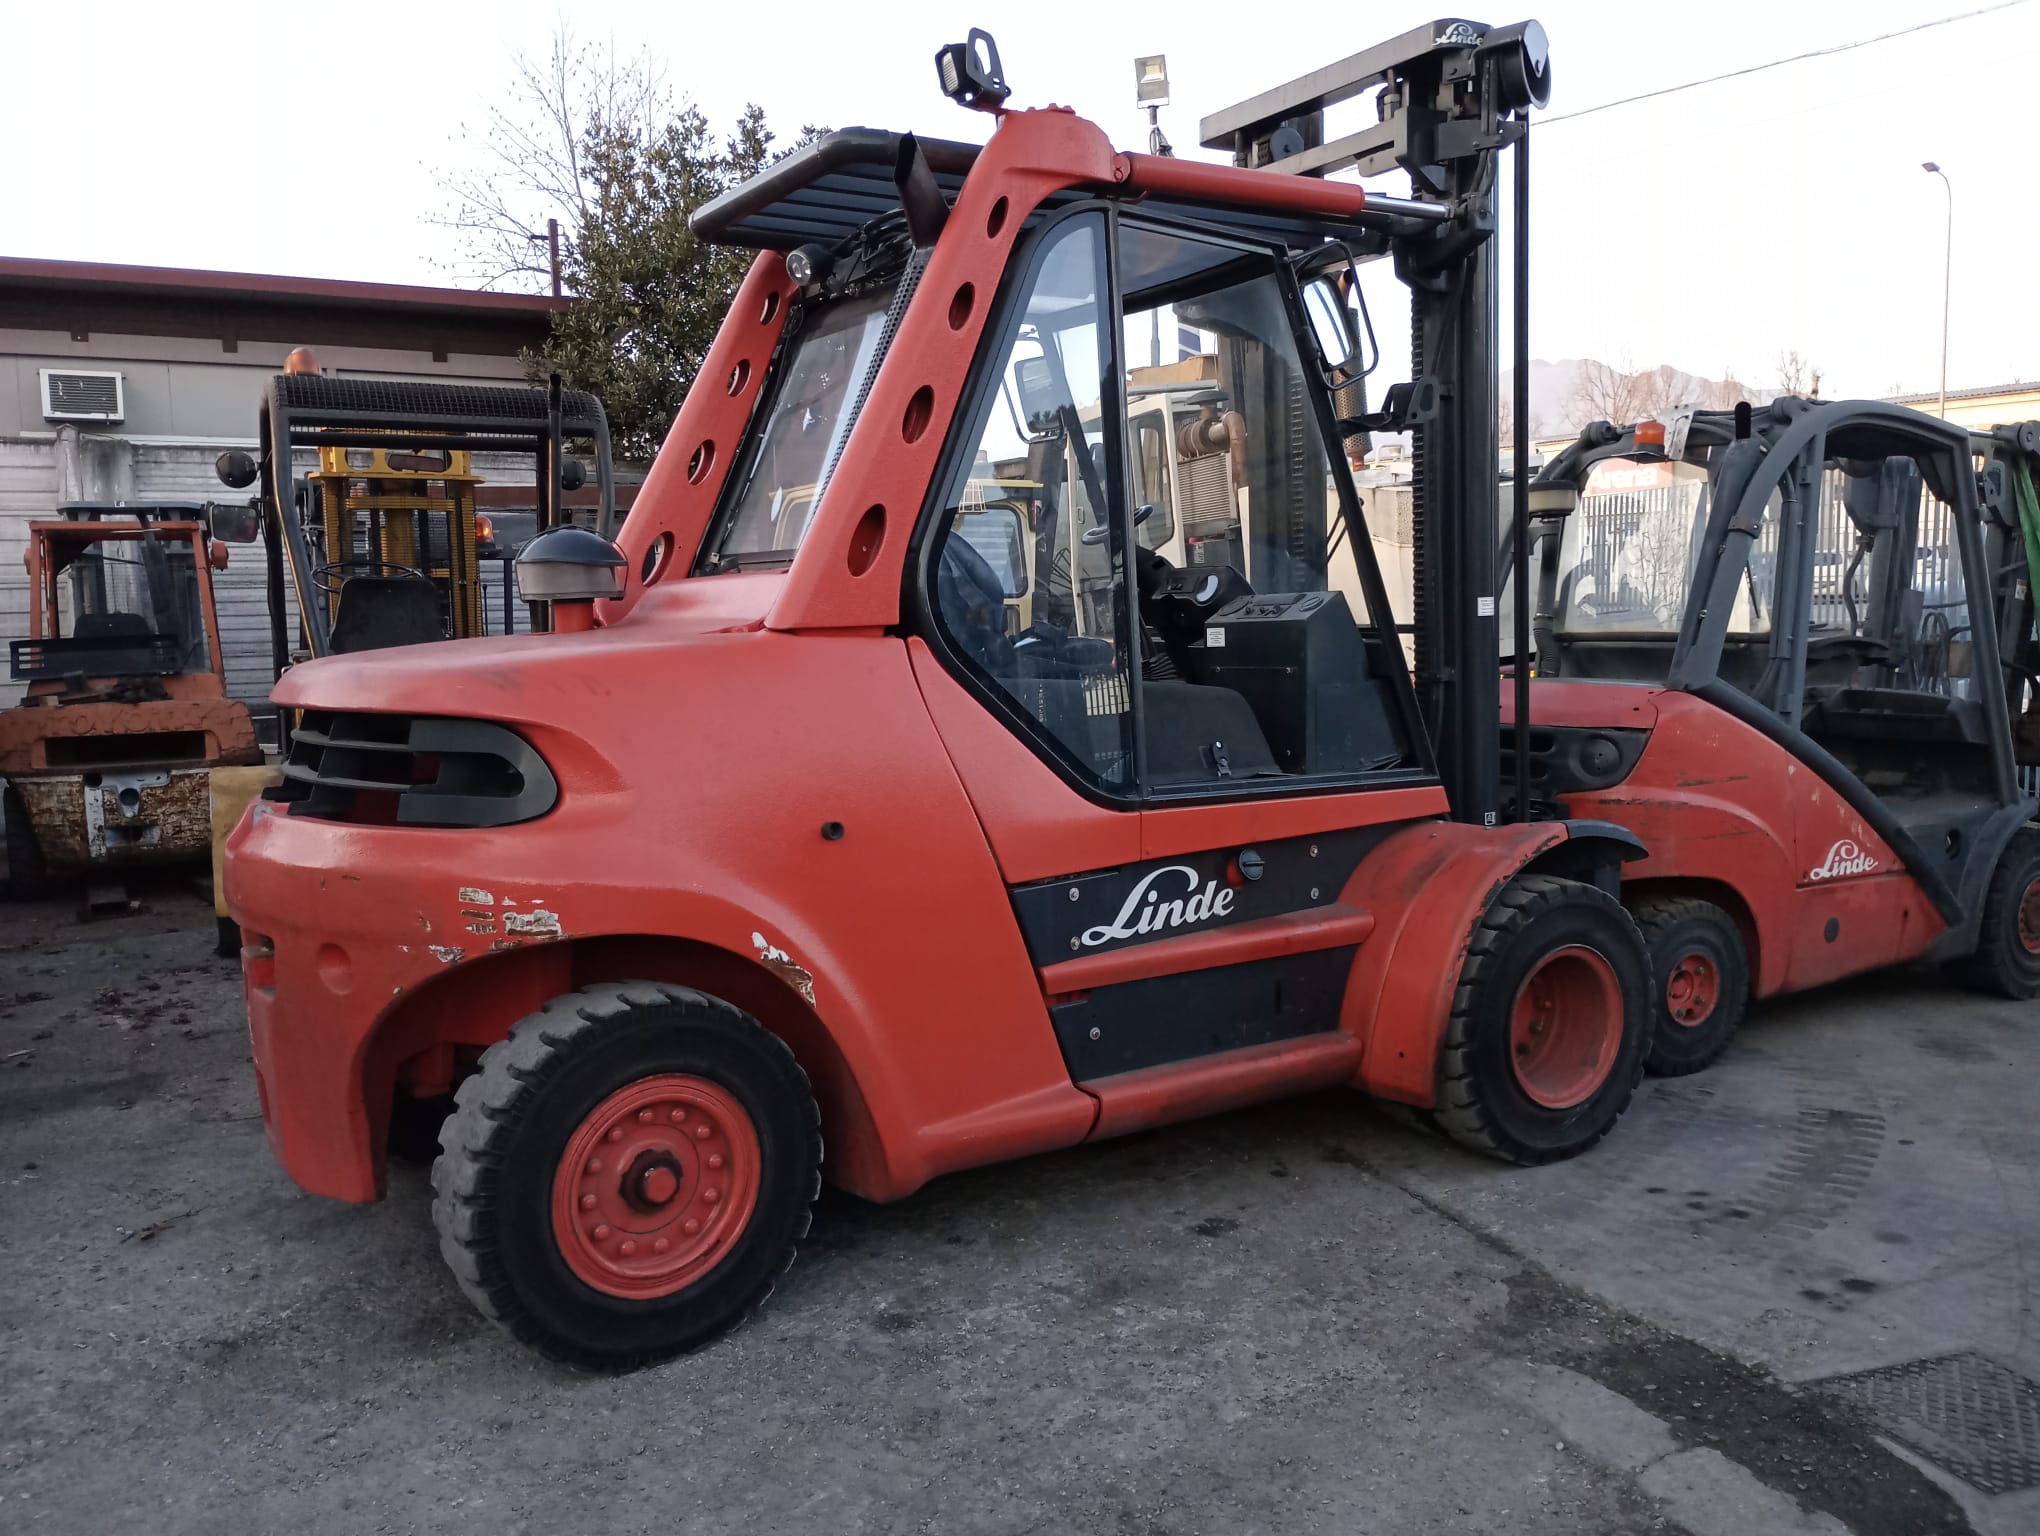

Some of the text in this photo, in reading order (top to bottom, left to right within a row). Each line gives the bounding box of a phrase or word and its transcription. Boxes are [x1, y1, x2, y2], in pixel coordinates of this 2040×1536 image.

[1432, 22, 1483, 46] Linde
[1809, 839, 1879, 880] Linde
[1081, 865, 1234, 946] Linde
